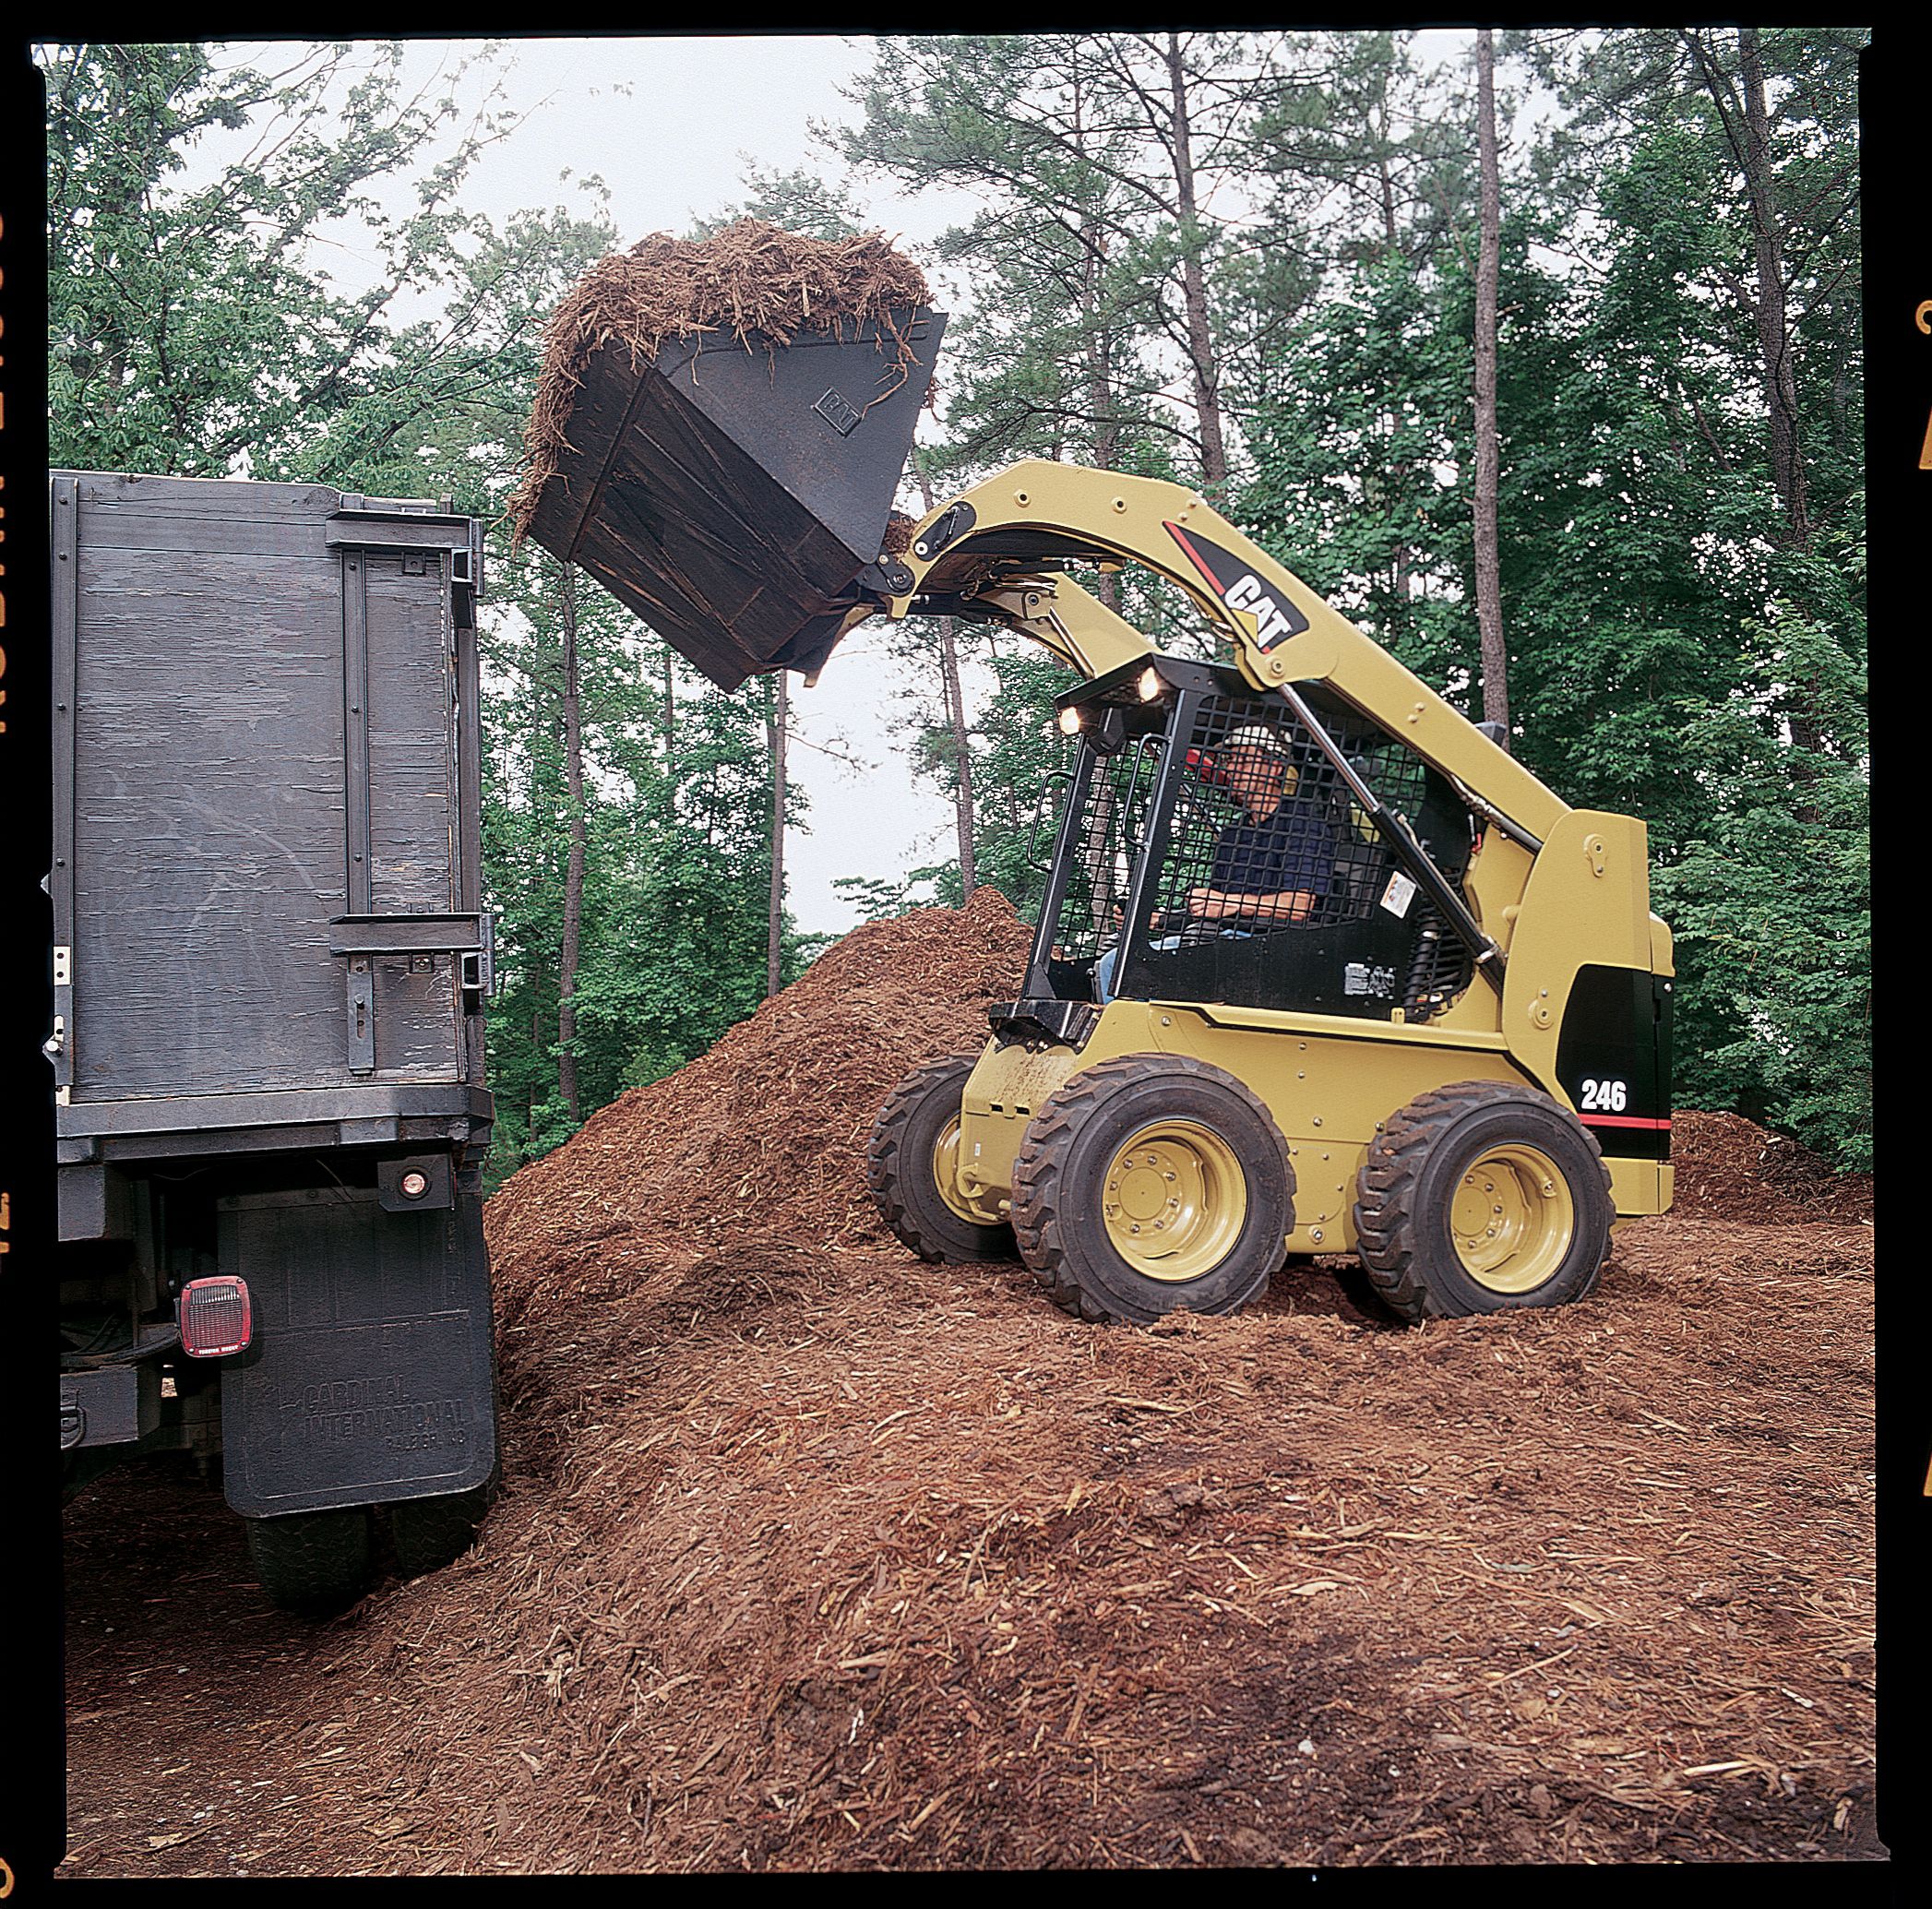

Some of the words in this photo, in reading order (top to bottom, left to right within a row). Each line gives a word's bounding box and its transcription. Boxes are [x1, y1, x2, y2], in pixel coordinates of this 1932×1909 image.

[818, 392, 859, 431] CAT
[1224, 574, 1293, 649] CAT
[1580, 1079, 1627, 1112] 246
[303, 1374, 411, 1414] CARDINAL
[304, 1398, 466, 1443] INTERNATIONAL
